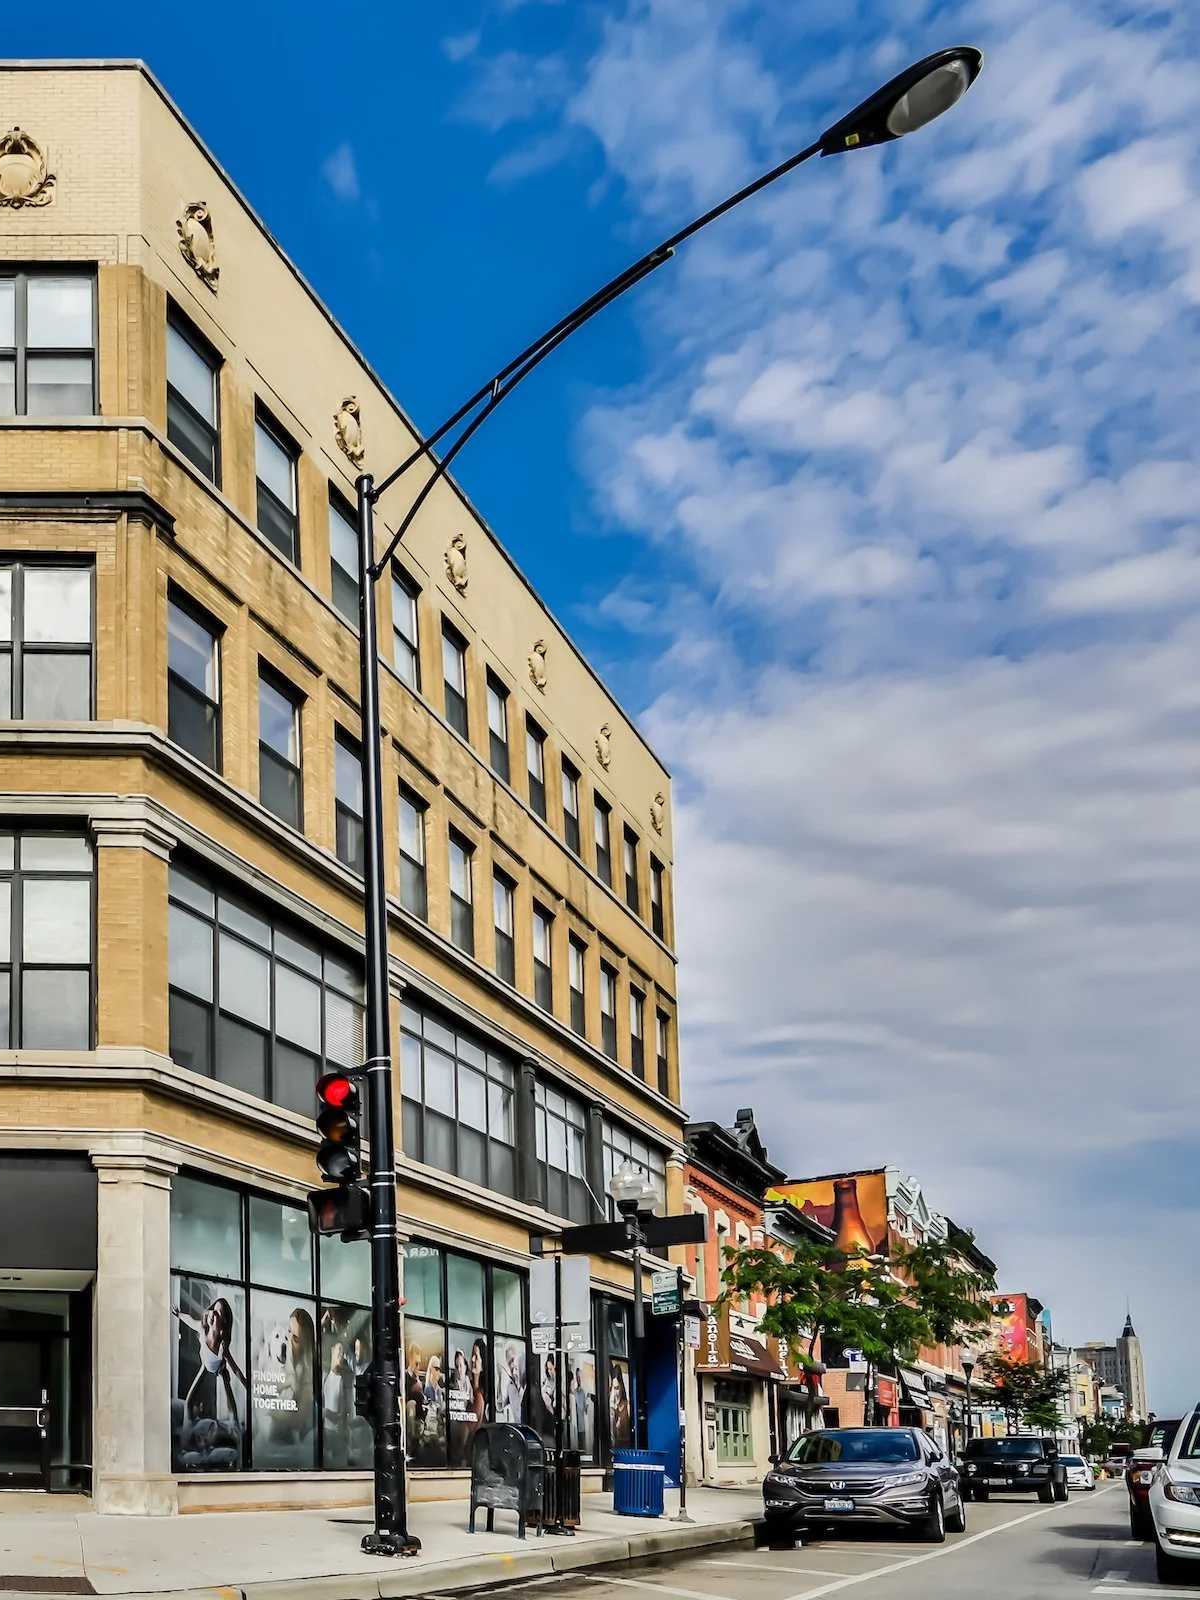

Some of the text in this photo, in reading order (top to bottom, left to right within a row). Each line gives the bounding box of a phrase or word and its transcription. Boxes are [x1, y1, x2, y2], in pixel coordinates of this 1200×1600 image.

[253, 1370, 286, 1383] FINDING
[253, 1383, 280, 1397] HOME,
[253, 1398, 299, 1411] TOGETHER.
